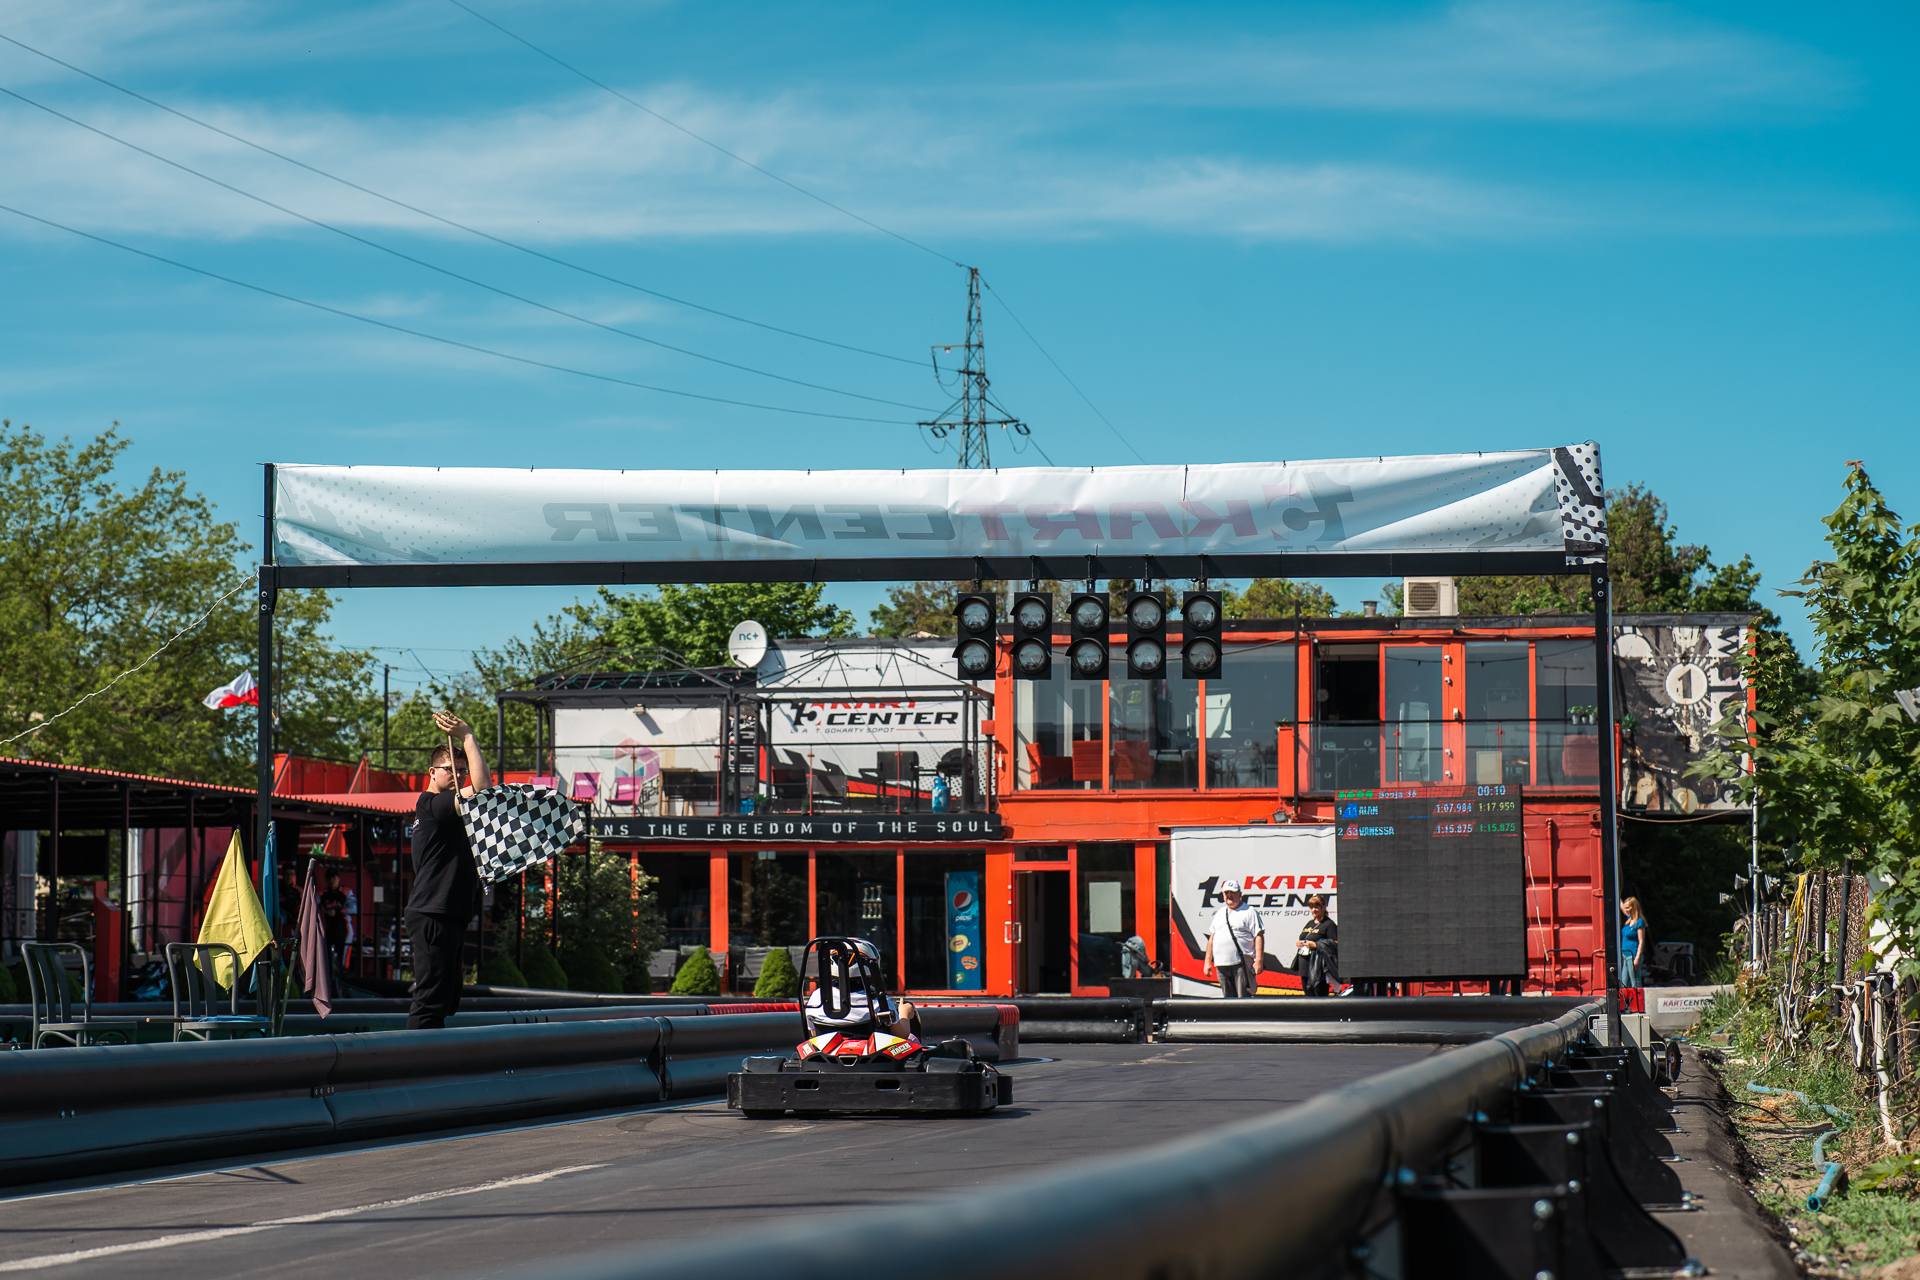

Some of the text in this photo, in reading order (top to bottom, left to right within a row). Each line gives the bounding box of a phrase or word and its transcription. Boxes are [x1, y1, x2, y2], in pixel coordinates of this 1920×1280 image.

[739, 632, 759, 641] nc+
[826, 712, 959, 725] CENTER
[1477, 785, 1506, 796] 00:10
[1358, 805, 1379, 816] ALAN
[1436, 802, 1472, 813] 1:07.984
[648, 823, 688, 836] THE
[707, 822, 813, 835] FREEDOM
[832, 821, 857, 834] OF
[877, 821, 918, 833] THE
[937, 820, 993, 833] SOUL
[1337, 827, 1343, 836] 2
[1358, 826, 1395, 836] VANESSA
[1243, 875, 1337, 890] KART
